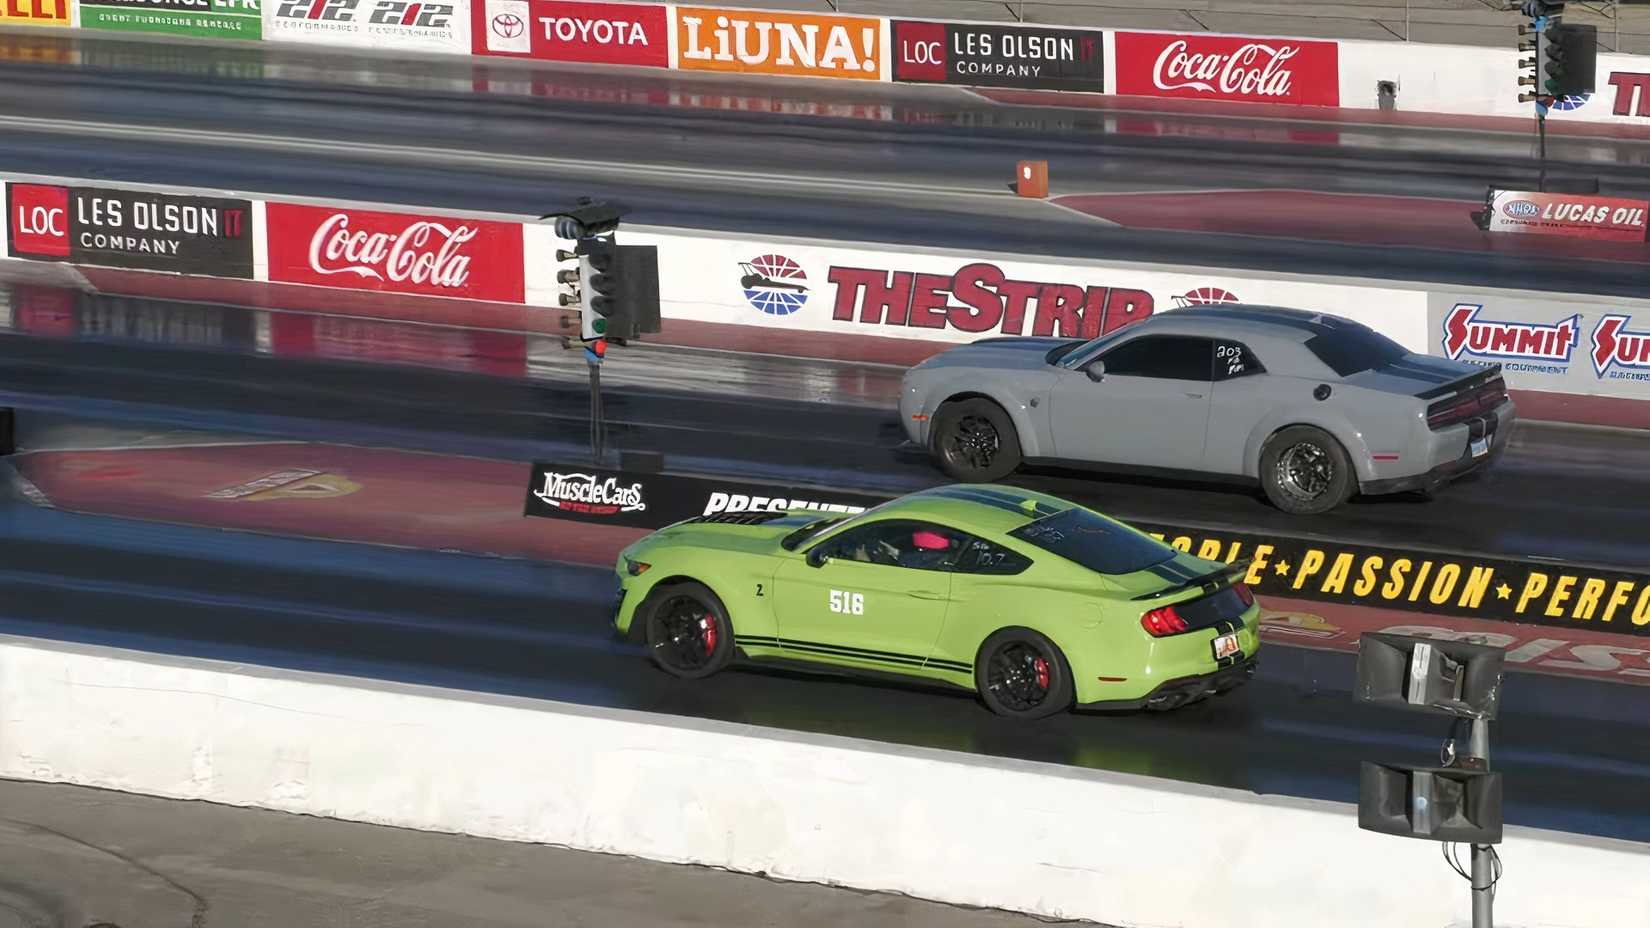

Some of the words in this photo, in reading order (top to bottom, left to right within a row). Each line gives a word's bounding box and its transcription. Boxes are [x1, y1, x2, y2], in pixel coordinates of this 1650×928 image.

[369, 1, 453, 28] 212
[538, 17, 648, 46] TOYOTA
[682, 16, 875, 72] LiUNA!
[903, 39, 941, 65] LOC
[954, 31, 992, 56] LES
[1002, 35, 1074, 61] OLSON
[956, 60, 1041, 78] COMPANY
[19, 205, 64, 237] LOC
[78, 197, 121, 228] LES
[134, 201, 217, 236] OLSON
[224, 208, 241, 239] IT
[1542, 203, 1610, 224] LUCAS
[1612, 207, 1645, 226] OIL
[80, 232, 181, 255] COMPANY
[1216, 345, 1241, 358] 203
[1292, 550, 1494, 609] PASSION
[829, 589, 864, 615] 516
